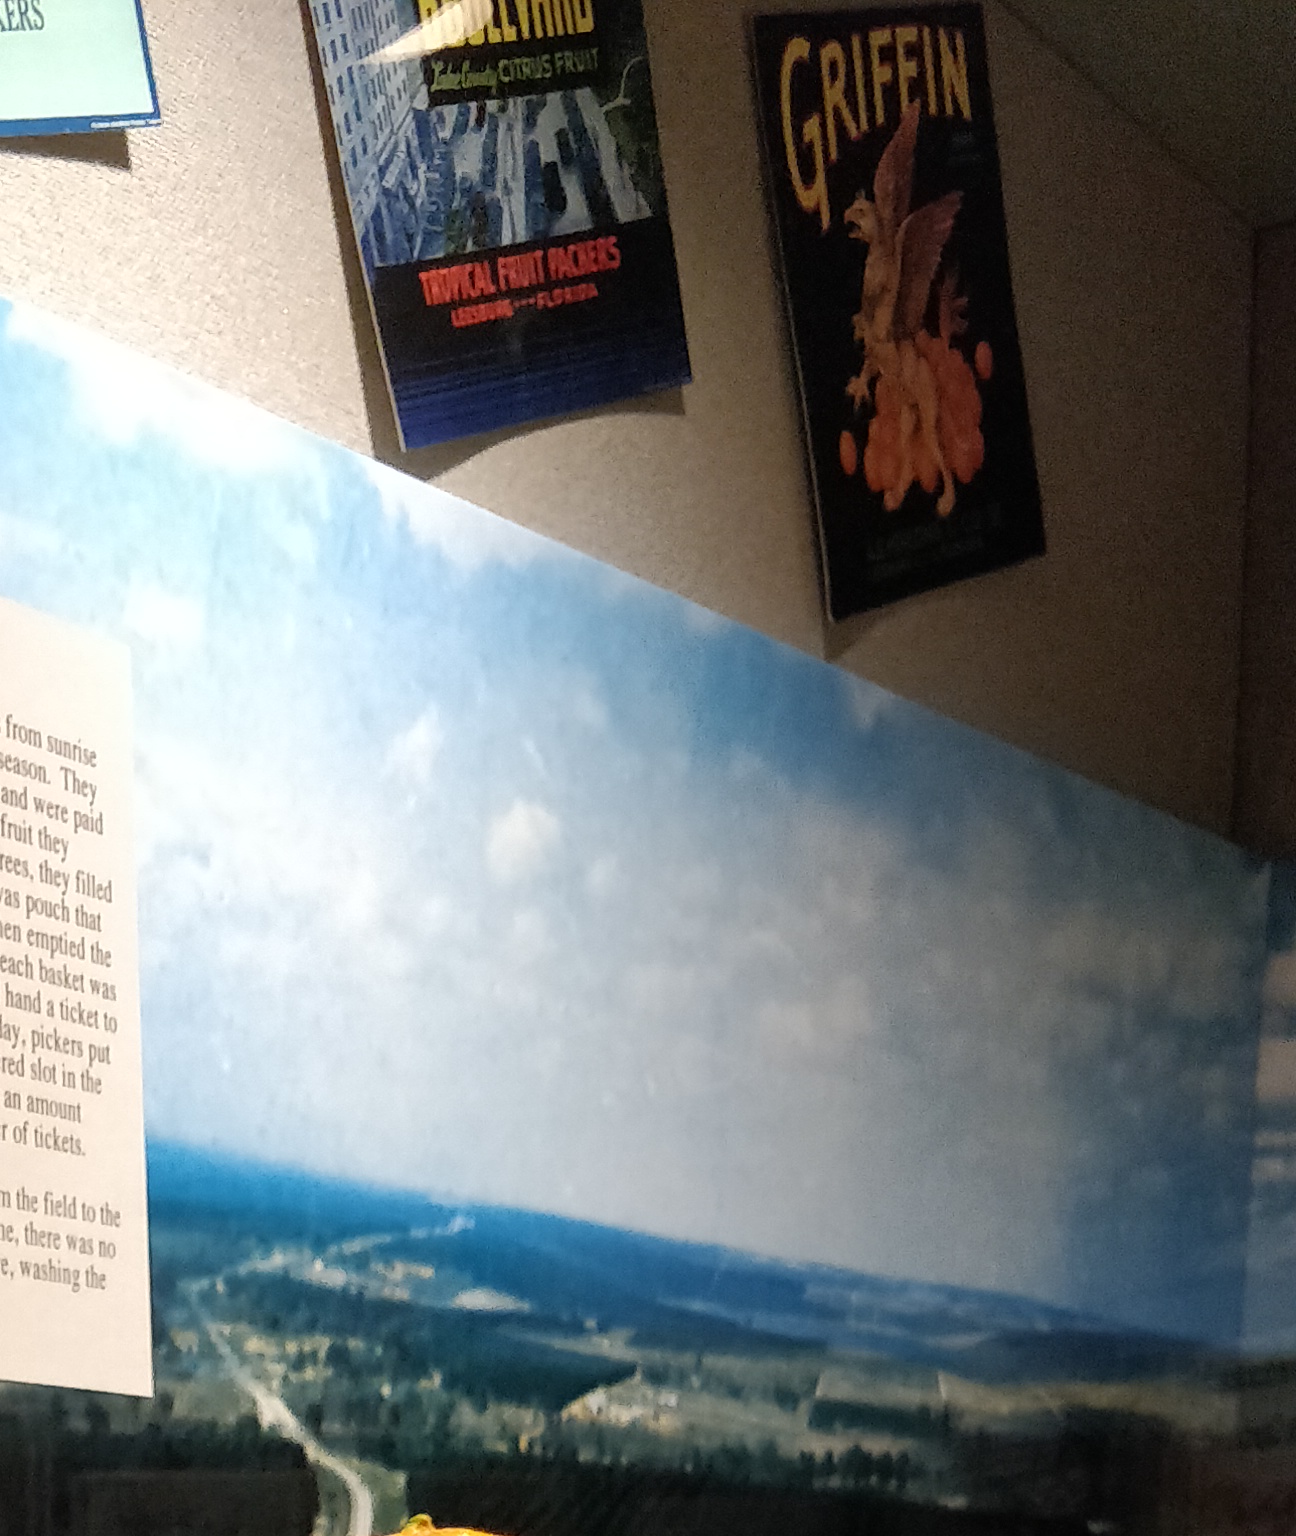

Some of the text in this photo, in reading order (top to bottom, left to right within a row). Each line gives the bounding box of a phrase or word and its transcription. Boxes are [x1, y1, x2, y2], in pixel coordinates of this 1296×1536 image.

[780, 25, 972, 235] GRIFFIN
[4, 712, 44, 750] from
[46, 734, 98, 769] sunrise
[58, 764, 98, 807] They
[0, 785, 29, 812] and
[32, 795, 70, 825] were
[72, 807, 105, 837] paid
[0, 812, 35, 847] fruit
[36, 824, 70, 865] they
[14, 1185, 39, 1215] the
[42, 1189, 79, 1221] field
[80, 1201, 97, 1224] to
[98, 1200, 122, 1229] the
[23, 1220, 62, 1252] there
[64, 1233, 95, 1257] was
[97, 1239, 118, 1260] no
[18, 1257, 82, 1294] washing
[83, 1263, 108, 1292] the
